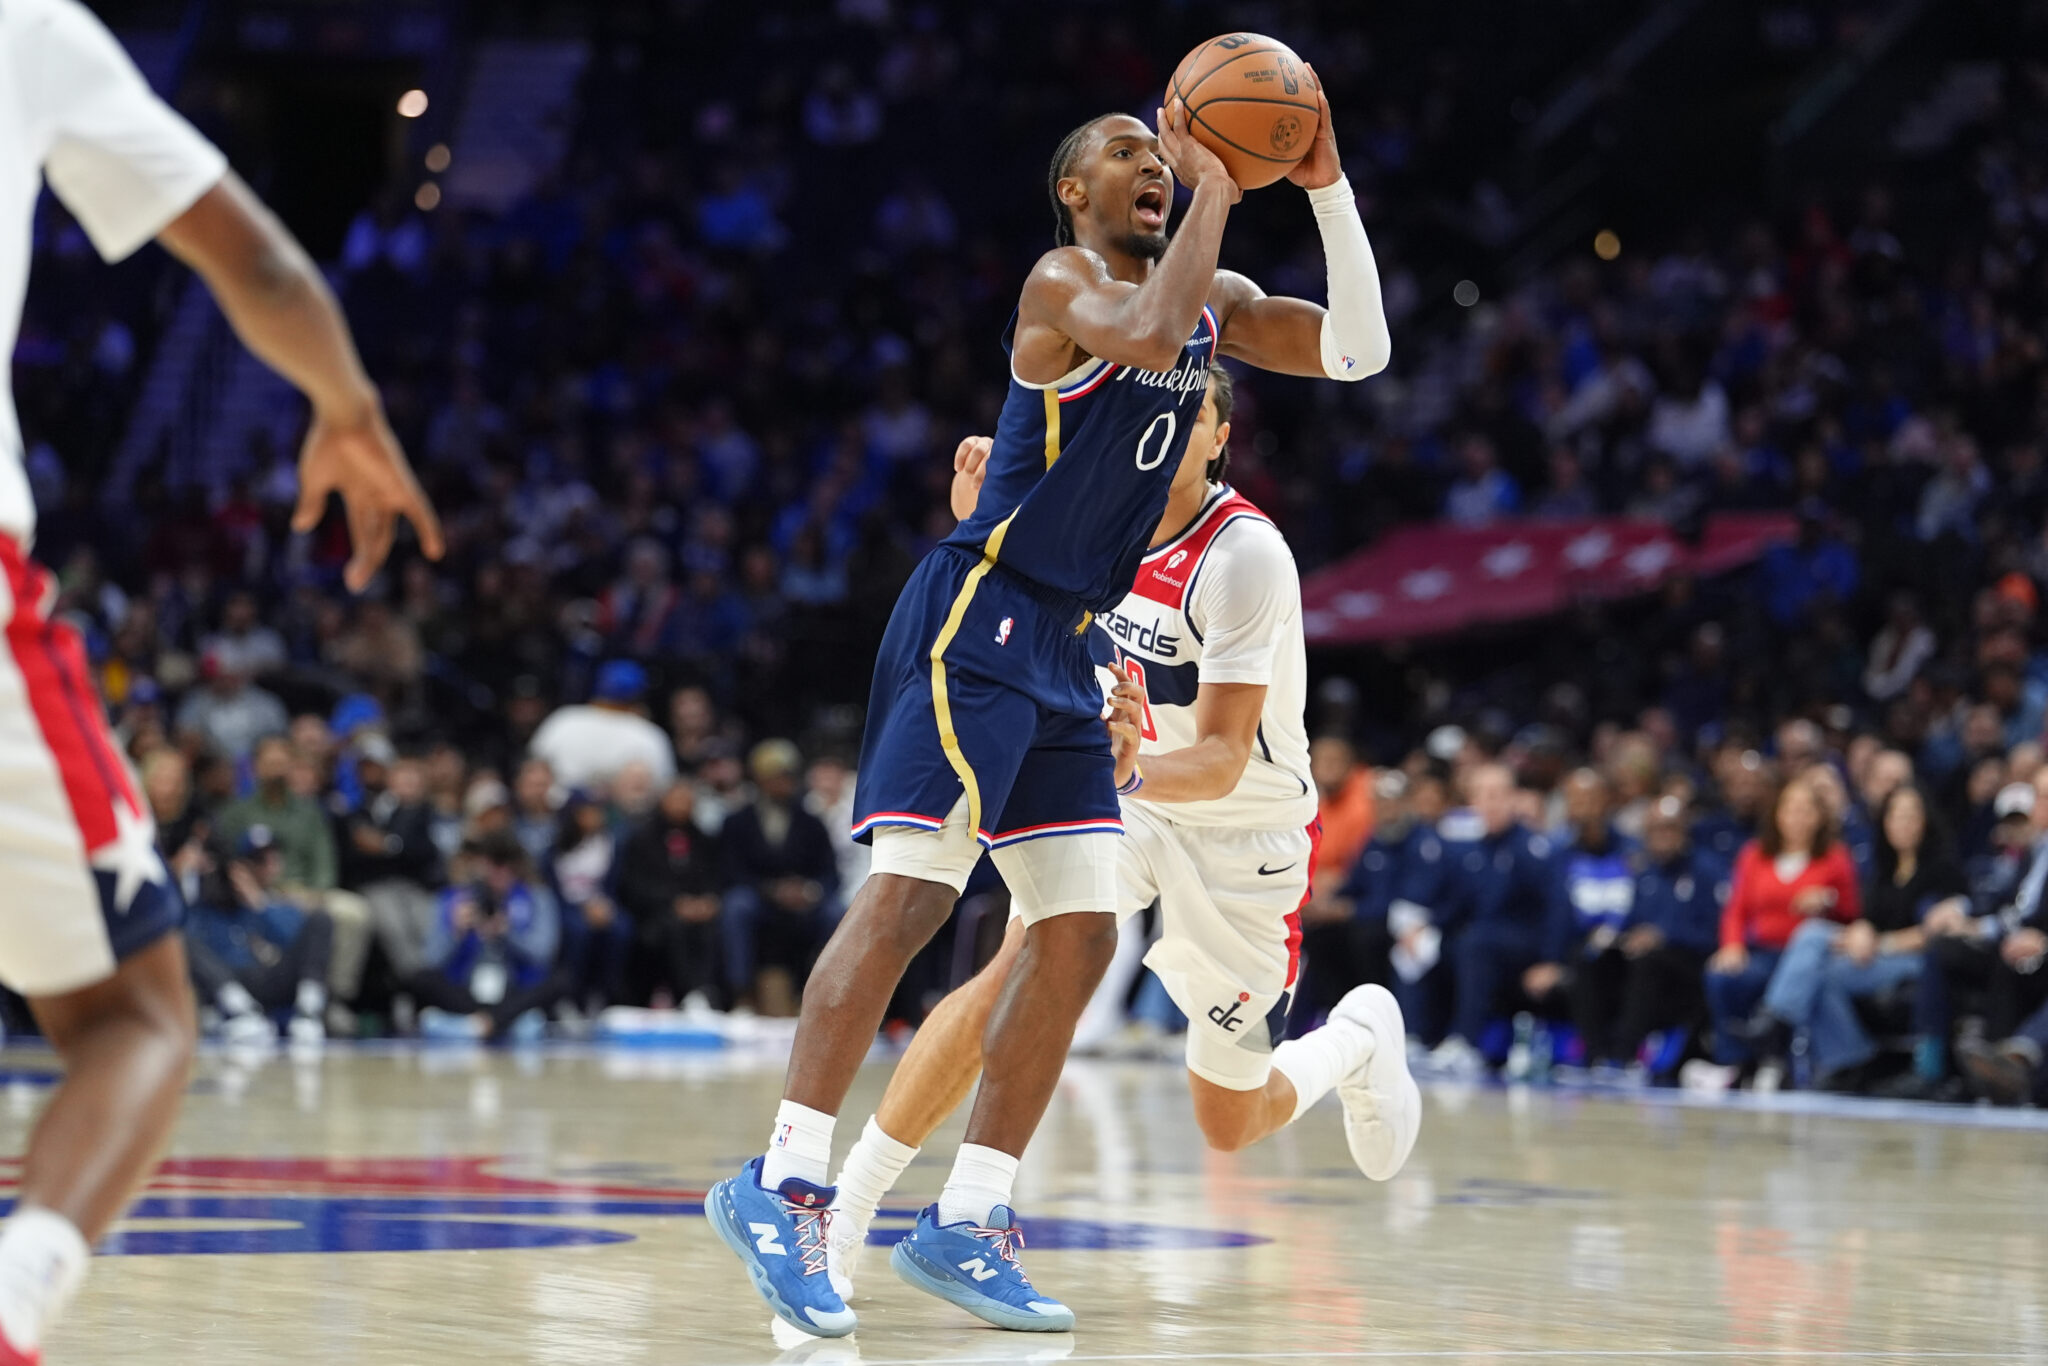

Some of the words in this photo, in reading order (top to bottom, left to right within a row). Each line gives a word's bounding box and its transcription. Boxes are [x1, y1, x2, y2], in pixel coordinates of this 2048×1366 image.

[1136, 410, 1176, 471] 0
[1152, 569, 1184, 588] Robinhood
[1098, 611, 1182, 658] zards
[748, 1222, 787, 1256] N
[957, 1257, 999, 1282] N
